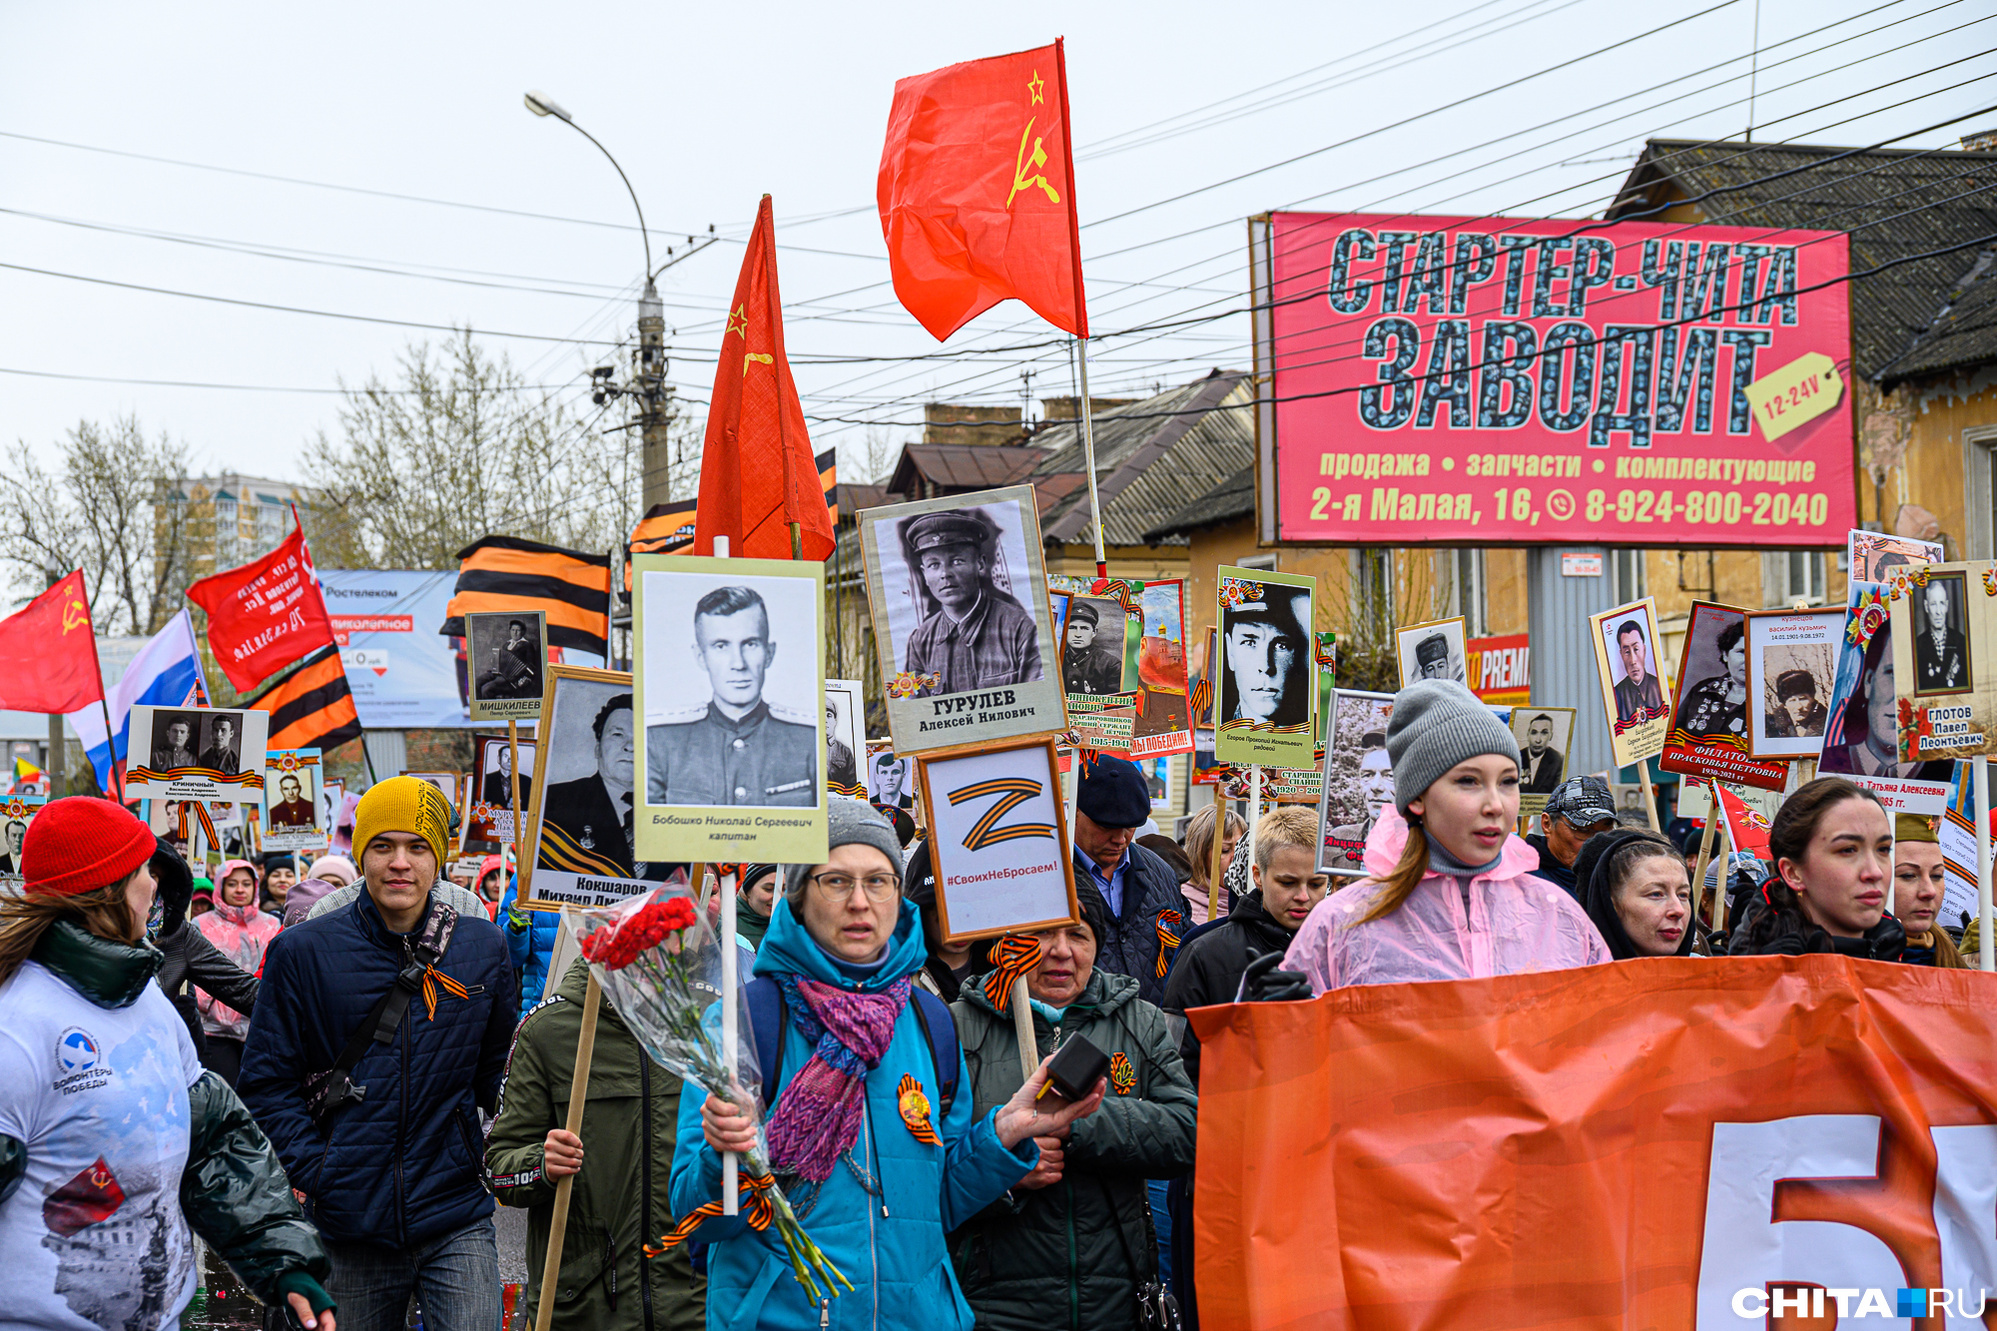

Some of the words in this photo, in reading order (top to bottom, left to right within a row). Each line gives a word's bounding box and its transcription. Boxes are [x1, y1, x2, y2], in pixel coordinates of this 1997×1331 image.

[1329, 228, 1800, 326] СТАРТЕР-ЧИТА
[1358, 317, 1773, 450] ЗАВОДИТ
[1763, 372, 1822, 422] 12-24V
[1319, 452, 1431, 480] продажа
[1466, 454, 1582, 480] запчасти
[1615, 457, 1816, 484] комплектующие
[1310, 487, 1364, 522] 2-я
[1370, 487, 1482, 527] Малая,
[1494, 488, 1542, 527] 16,
[1586, 488, 1829, 527] 8-924-800-2040
[326, 587, 398, 598] Ростелеком
[1781, 615, 1814, 623] кузнецов
[1768, 625, 1798, 633] василий
[1798, 624, 1827, 633] кузьмич
[479, 701, 541, 711] МИШКИЛЕЕВ
[932, 690, 1016, 716] ГУРУЛЕВ
[1068, 693, 1134, 706] ИННОКЕНТИЙ
[919, 713, 974, 732] Алексей
[978, 707, 1036, 724] Нилович
[1928, 707, 1972, 721] ГЛОТОВ
[1935, 723, 1968, 734] Павел
[1090, 737, 1130, 748] 1915-1941
[1146, 731, 1188, 751] ПОБЕДИМ!
[1245, 735, 1271, 744] Прокопий
[1920, 734, 1983, 749] Леонтьевич
[1253, 744, 1276, 752] рядовой
[1694, 746, 1762, 766] ФИЛАТО
[1669, 752, 1729, 769] ПРАСКОВЬЯ
[1729, 762, 1783, 780] ПЕТРОВНА
[1701, 767, 1736, 779] 1930-2021
[1276, 786, 1297, 794] 1920
[1867, 780, 1898, 793] Татьяна
[1900, 783, 1946, 796] Алексеевна
[1895, 799, 1906, 808] гг.
[652, 815, 703, 825] Бобошко
[705, 815, 752, 826] Николай
[754, 816, 813, 828] Сергеевич
[708, 832, 757, 841] капитан
[946, 860, 1059, 886] #СвоихНеБросаем!
[576, 876, 648, 896] Кокшаров
[63, 1079, 108, 1096] ПОБЕДЫ
[1695, 1113, 1997, 1331] Б
